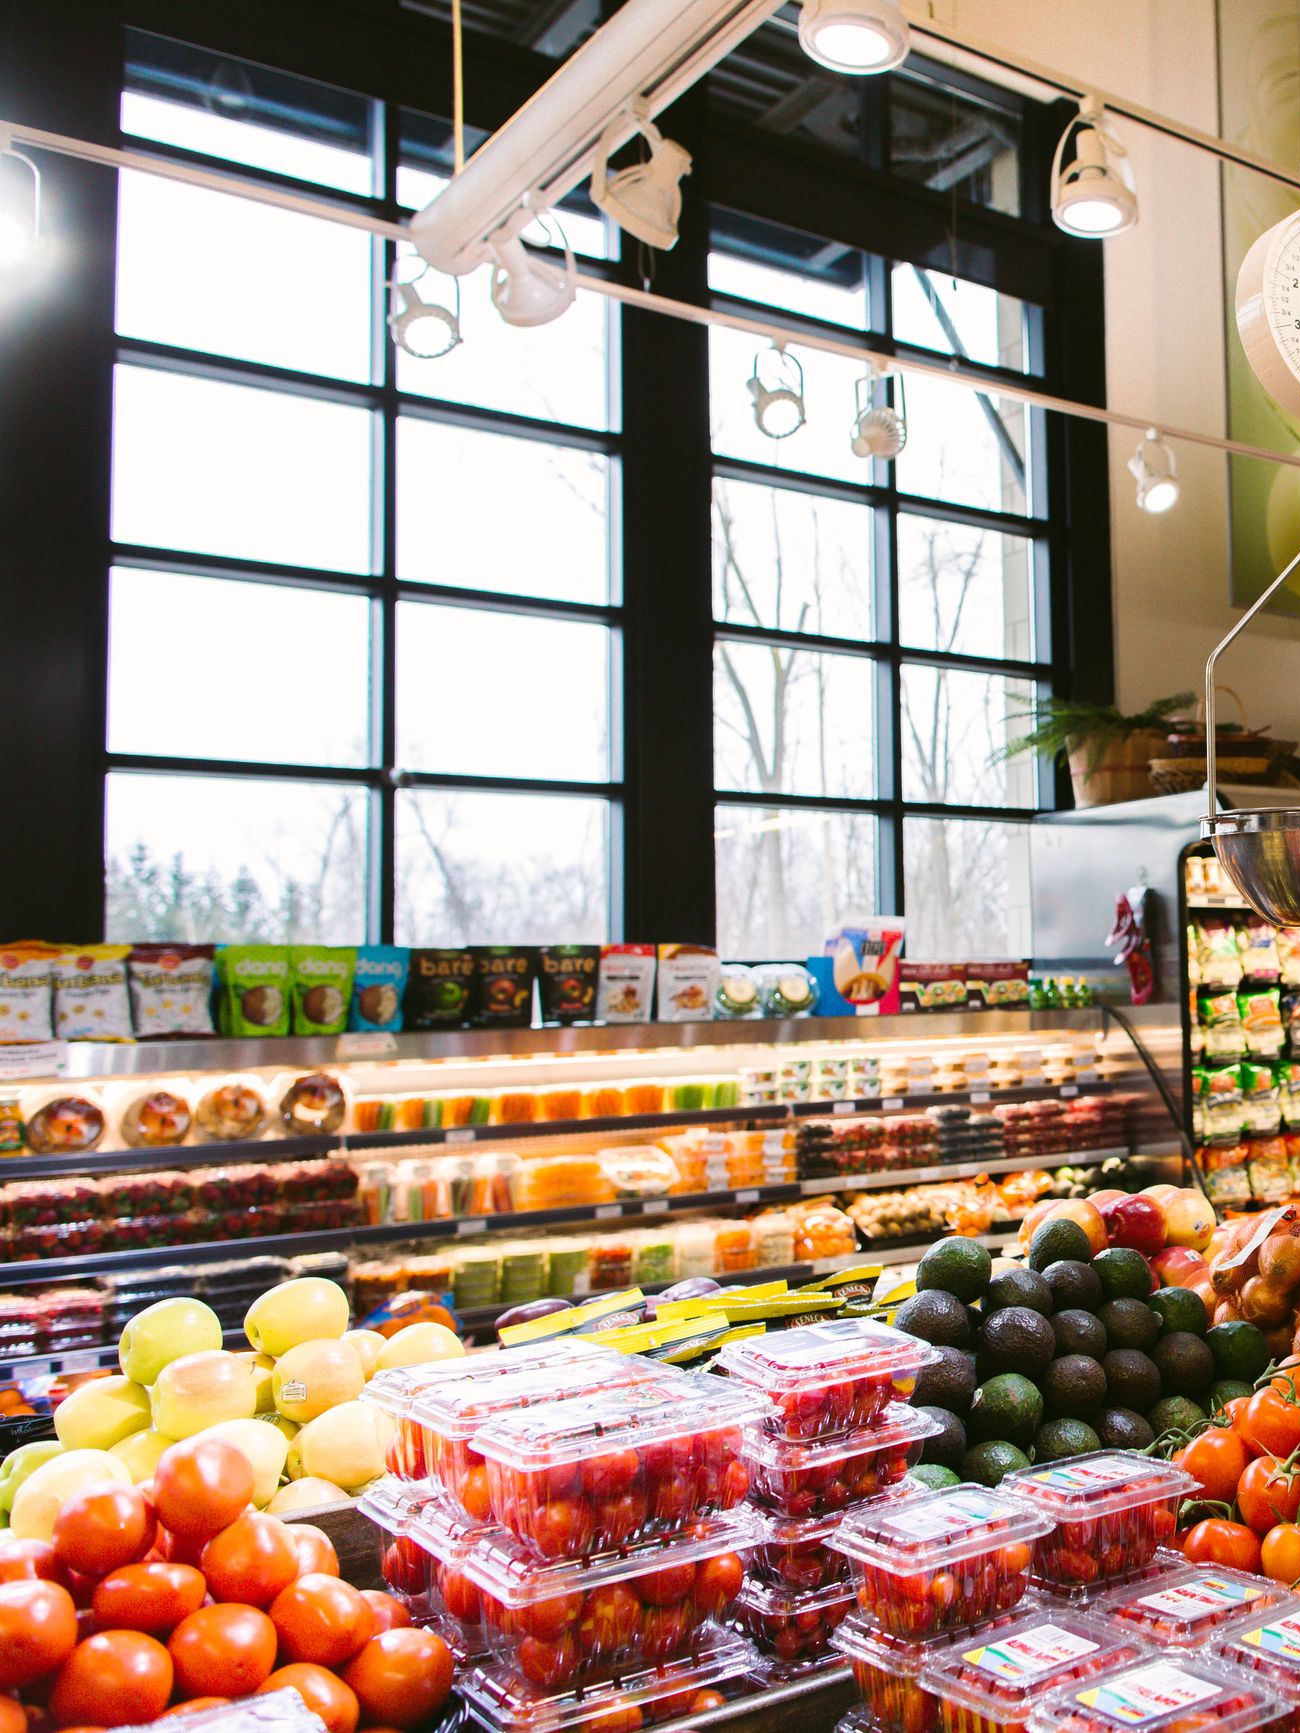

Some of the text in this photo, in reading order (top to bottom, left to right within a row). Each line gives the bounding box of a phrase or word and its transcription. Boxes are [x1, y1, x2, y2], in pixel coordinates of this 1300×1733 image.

[1292, 278, 1299, 288] 2
[1294, 319, 1300, 330] 3
[543, 955, 595, 974] bare
